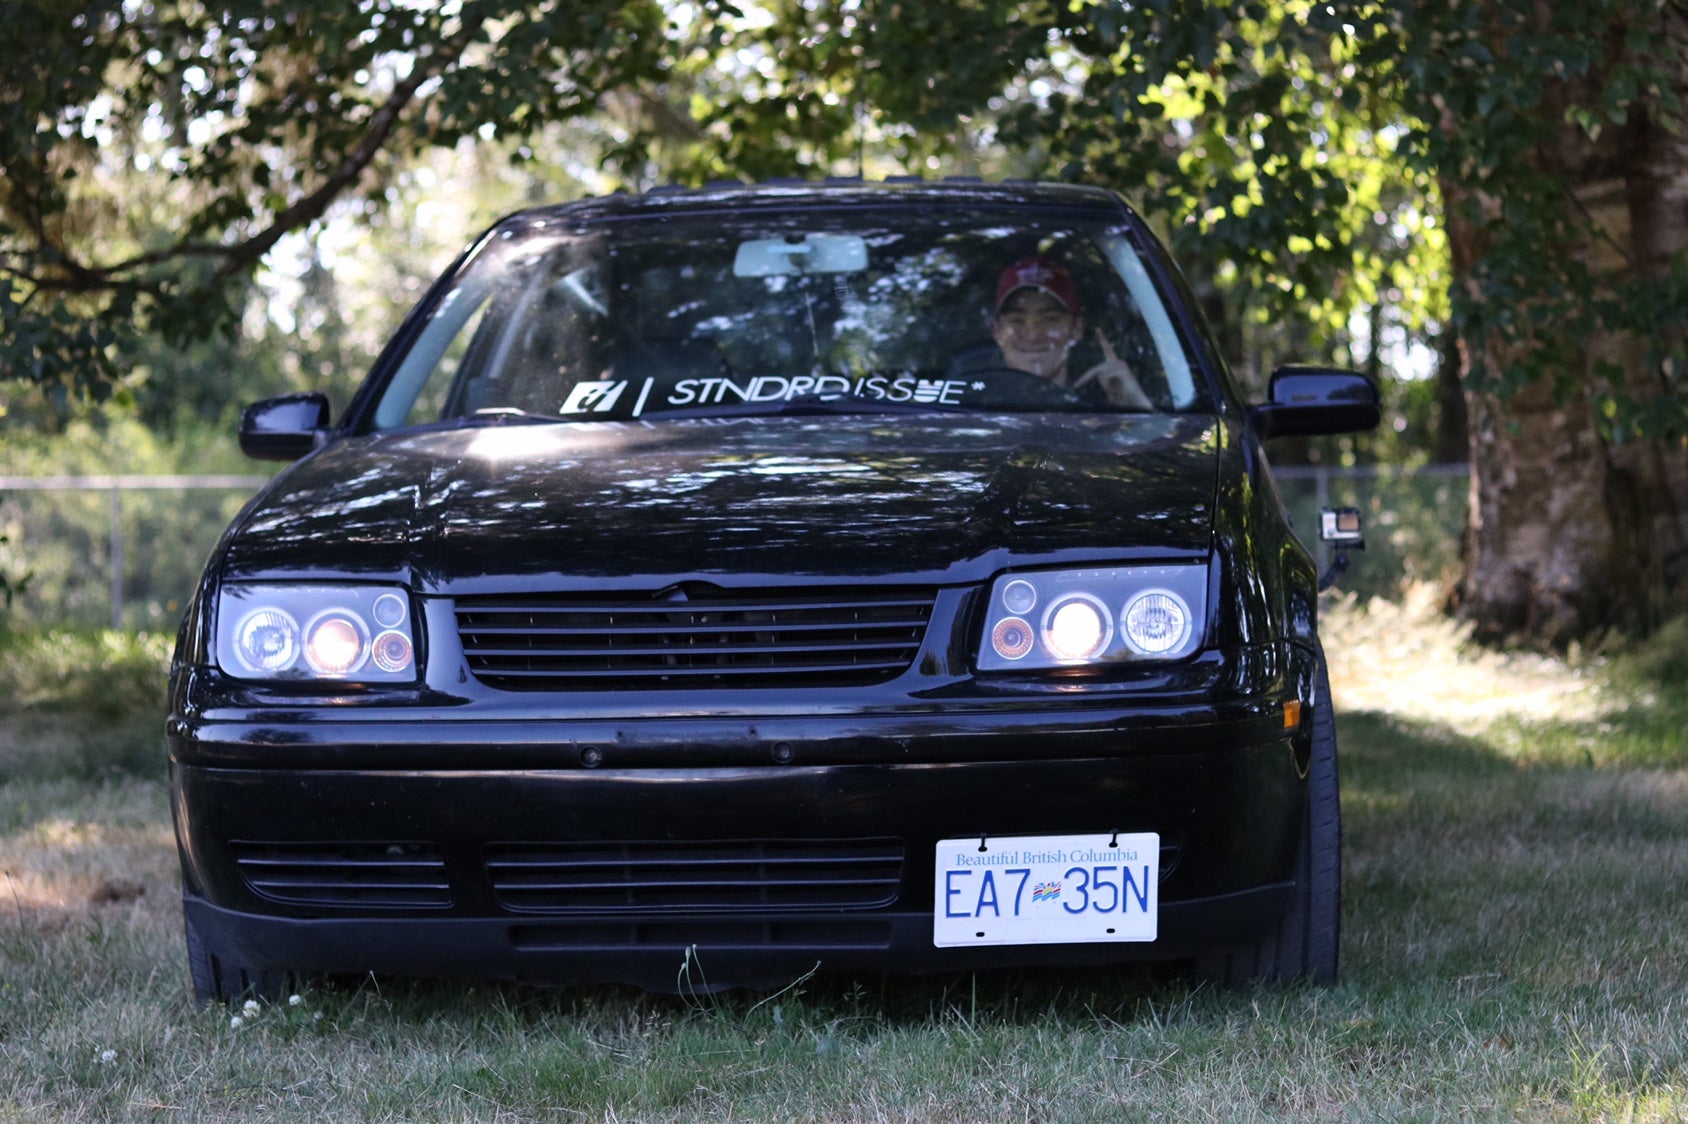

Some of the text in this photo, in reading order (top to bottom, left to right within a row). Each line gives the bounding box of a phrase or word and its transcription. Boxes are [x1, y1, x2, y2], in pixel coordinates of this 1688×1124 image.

[667, 376, 851, 405] STNDRD
[956, 848, 1138, 866] Beautiful British Columbia
[945, 865, 1149, 918] EA7 35N
